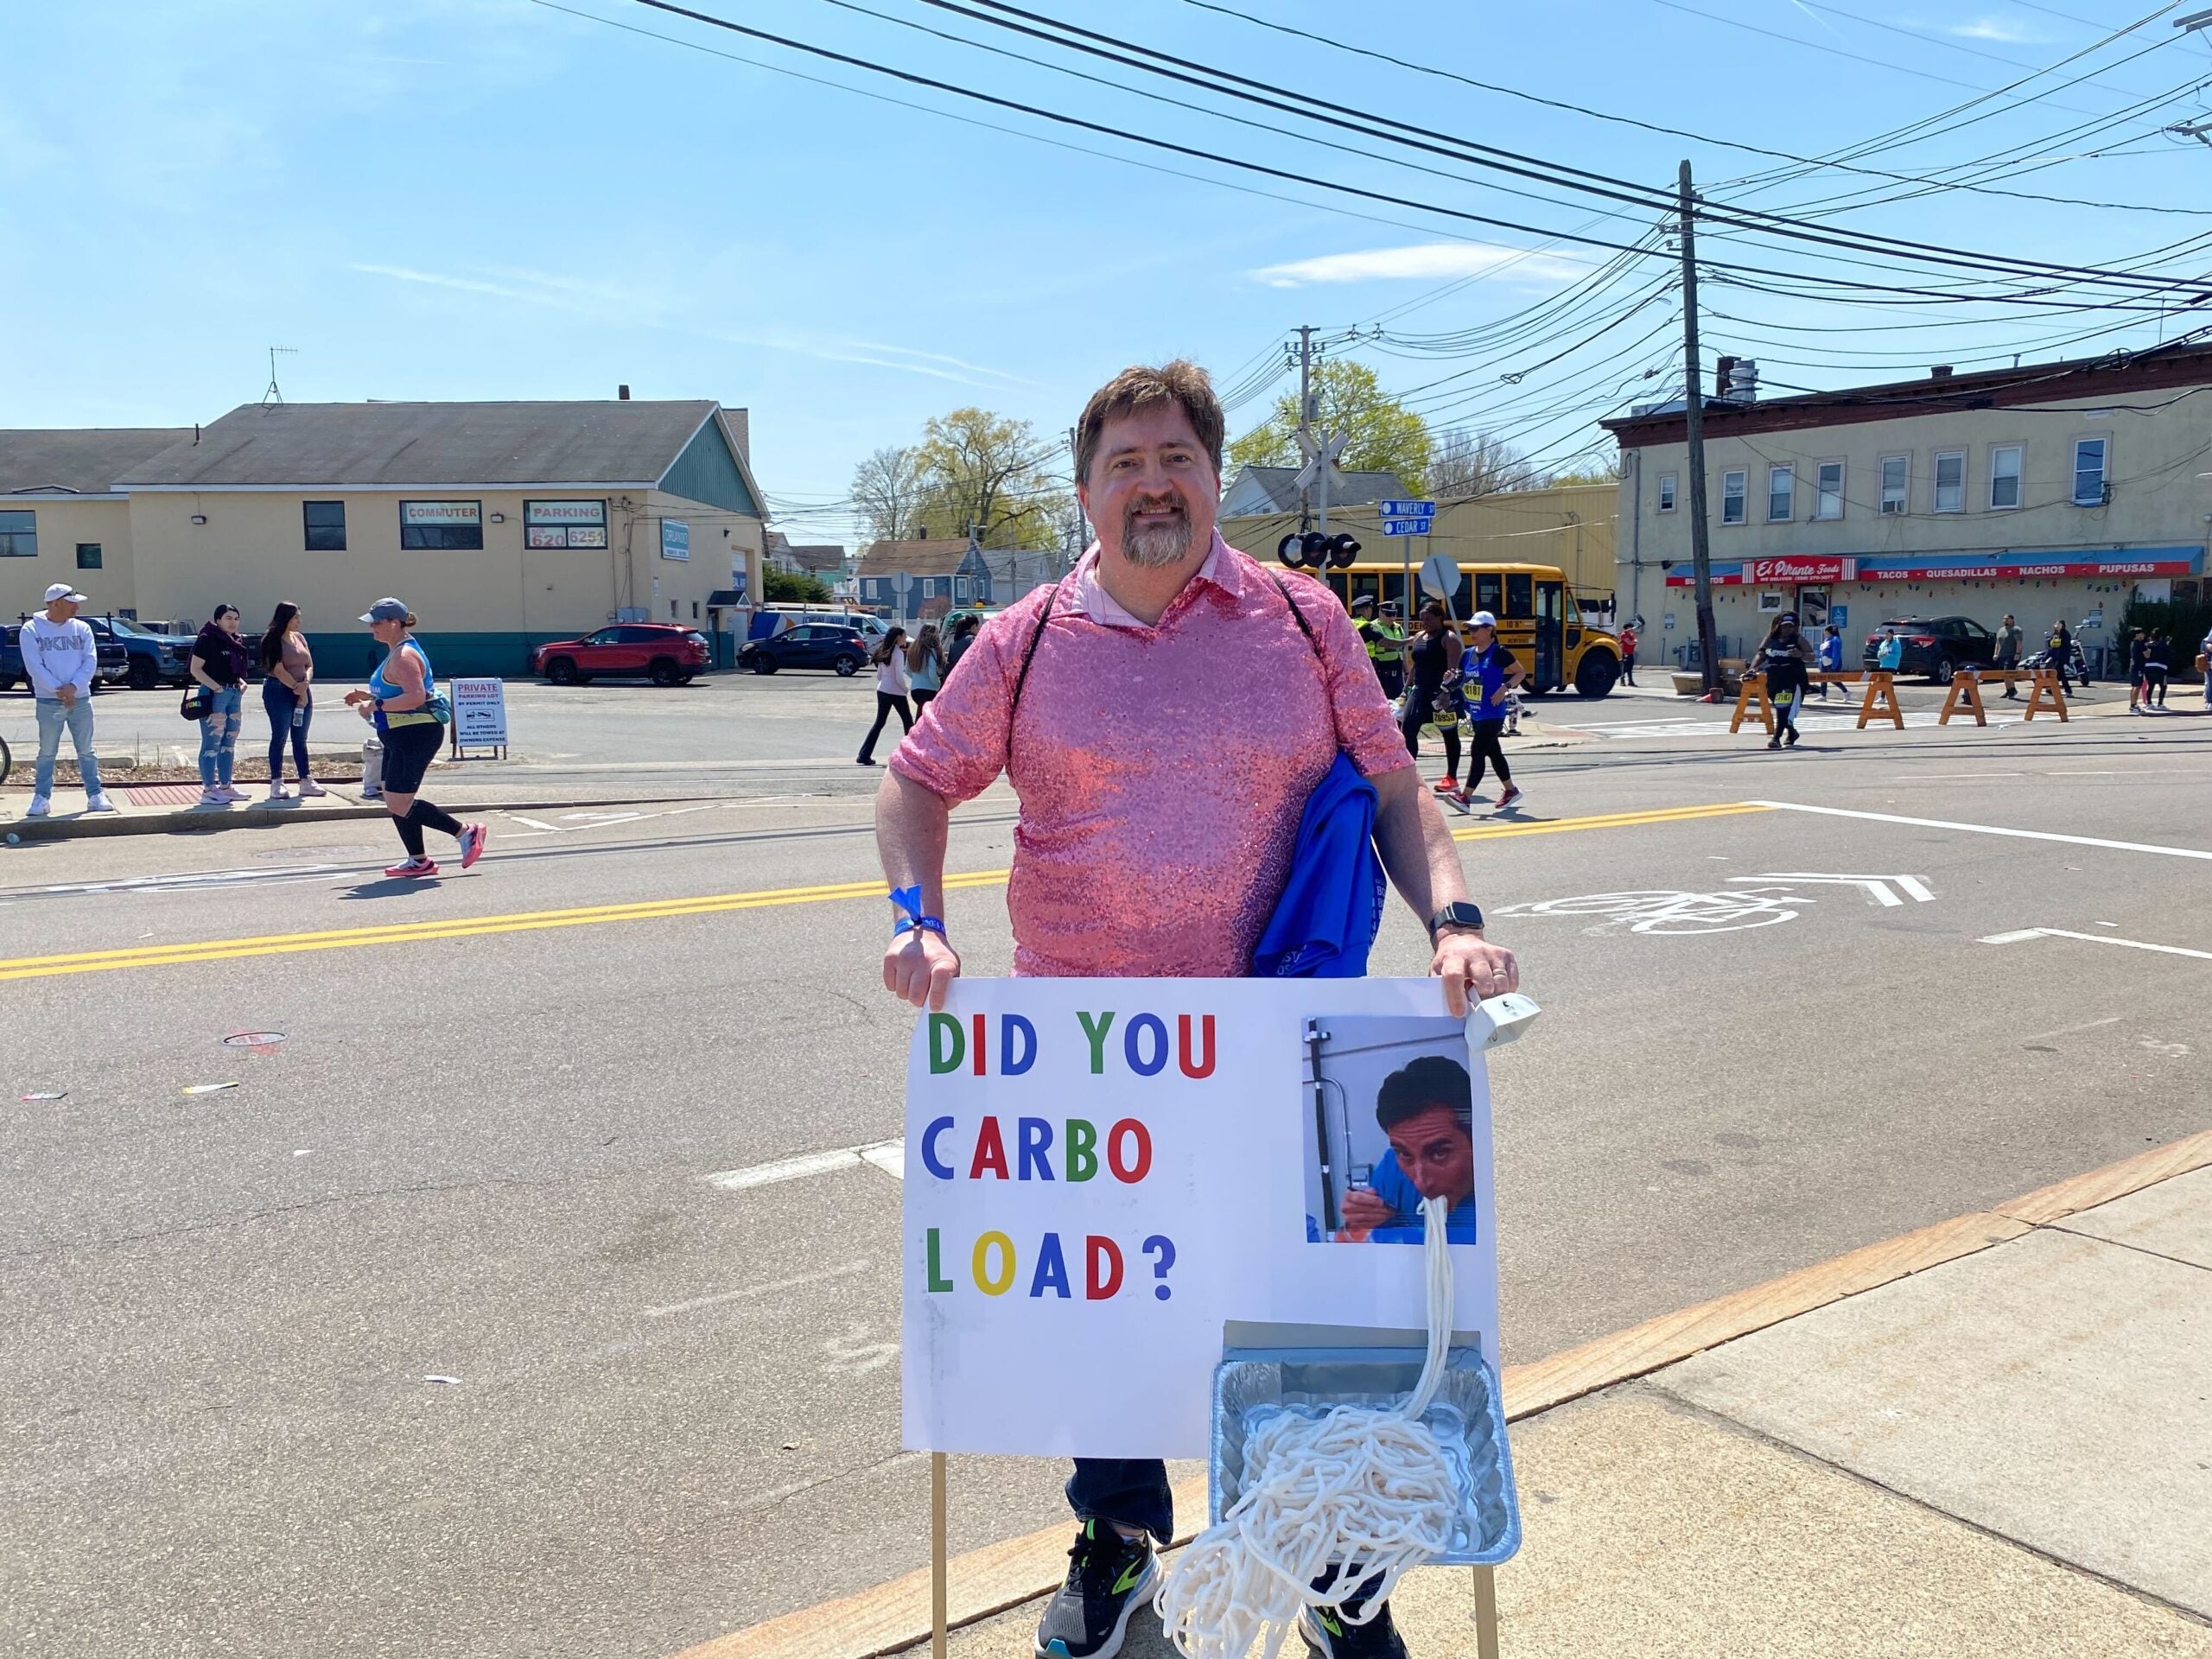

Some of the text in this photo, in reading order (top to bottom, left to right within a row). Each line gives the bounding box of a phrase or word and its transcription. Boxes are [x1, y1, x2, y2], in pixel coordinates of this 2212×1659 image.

[409, 508, 477, 518] COMMUTER
[533, 507, 601, 518] PARKING
[1396, 502, 1434, 515] WAVERLY ST
[1396, 520, 1427, 534] CEDAR ST
[532, 535, 565, 546] 620
[1756, 560, 1840, 577] El Pikante Foods
[1877, 563, 2155, 580] TACOS QUESADILLAS NACHOS PUPUSAS
[1685, 576, 1725, 585] BUTOS
[830, 616, 845, 625] AIR
[458, 683, 498, 692] PRIVATE
[928, 1010, 1217, 1080] DID YOU
[921, 1116, 1153, 1185] CARBO
[926, 1228, 1177, 1301] LOAD?
